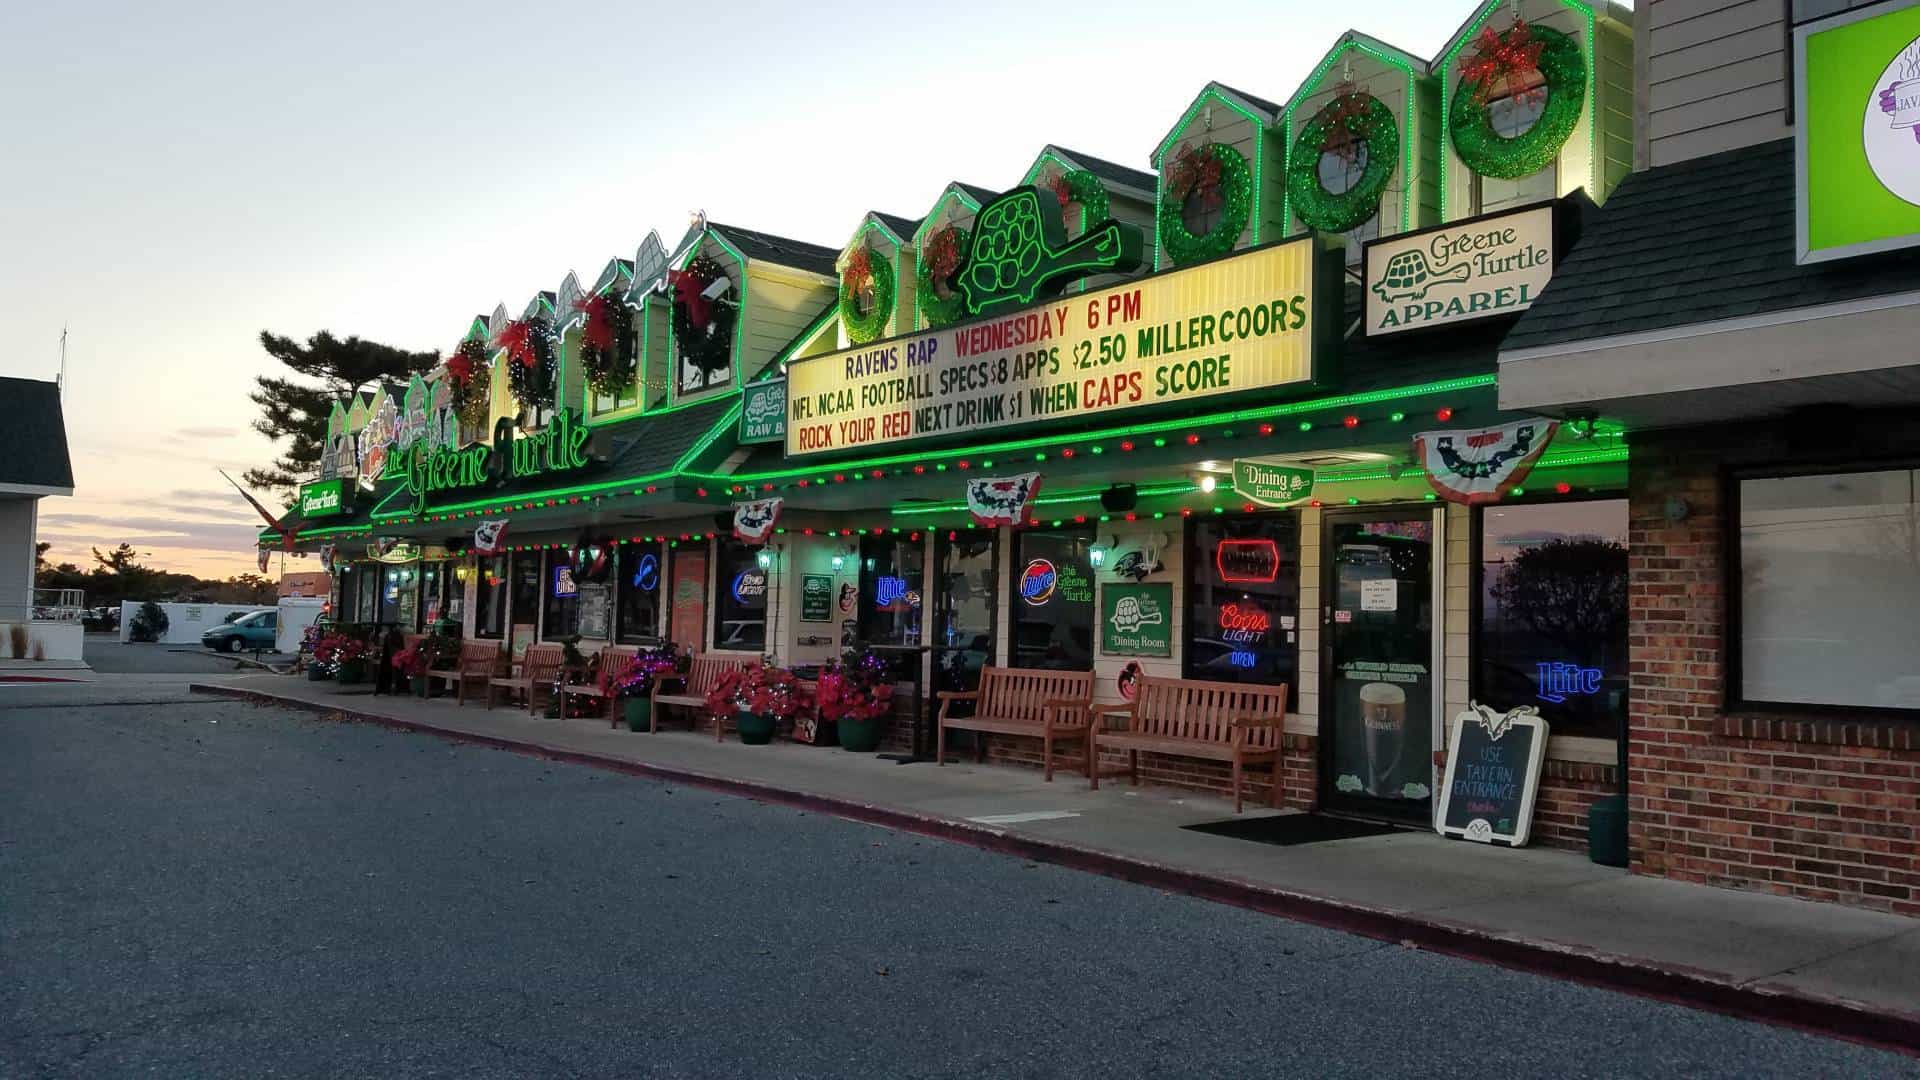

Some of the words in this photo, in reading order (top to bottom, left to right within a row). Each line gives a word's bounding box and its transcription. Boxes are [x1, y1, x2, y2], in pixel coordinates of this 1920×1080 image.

[1897, 96, 1920, 111] JAV
[1430, 227, 1517, 267] Greene
[1473, 245, 1549, 277] Turtle
[1378, 284, 1537, 329] APPAREL
[846, 346, 898, 380] RAVENS
[907, 338, 938, 368] RAP
[955, 306, 1069, 358] WEDNESDAY
[1087, 300, 1100, 329] 6
[1107, 290, 1141, 325] PM
[861, 373, 933, 408] FOOTBALL
[1012, 347, 1060, 381] APPS
[1073, 333, 1126, 371] $2.50
[799, 424, 833, 450] ROCK
[839, 417, 875, 444] YOUR
[882, 411, 912, 438] RED
[915, 403, 952, 434] NEXT
[956, 395, 1005, 426] DRINK
[1010, 390, 1023, 419] $1
[1030, 381, 1077, 415] WHEN
[1083, 371, 1142, 409] CAPS
[1155, 354, 1230, 397] SCORE
[747, 423, 772, 437] RAW
[407, 437, 489, 515] Greene
[493, 407, 589, 488] Turtle
[1243, 465, 1287, 490] Dining
[1256, 485, 1292, 499] Entrance
[1057, 574, 1088, 589] Greene
[1063, 587, 1092, 602] Turtle
[1220, 604, 1270, 630] Coors
[1111, 634, 1139, 649] Dining
[1141, 635, 1166, 648] Room
[1222, 629, 1264, 643] LIGHT
[1231, 651, 1255, 668] OPEN
[1536, 662, 1602, 703] Lite
[1480, 746, 1504, 762] USE
[1466, 764, 1513, 783] TAVERN
[1454, 780, 1518, 800] ENTRANCE
